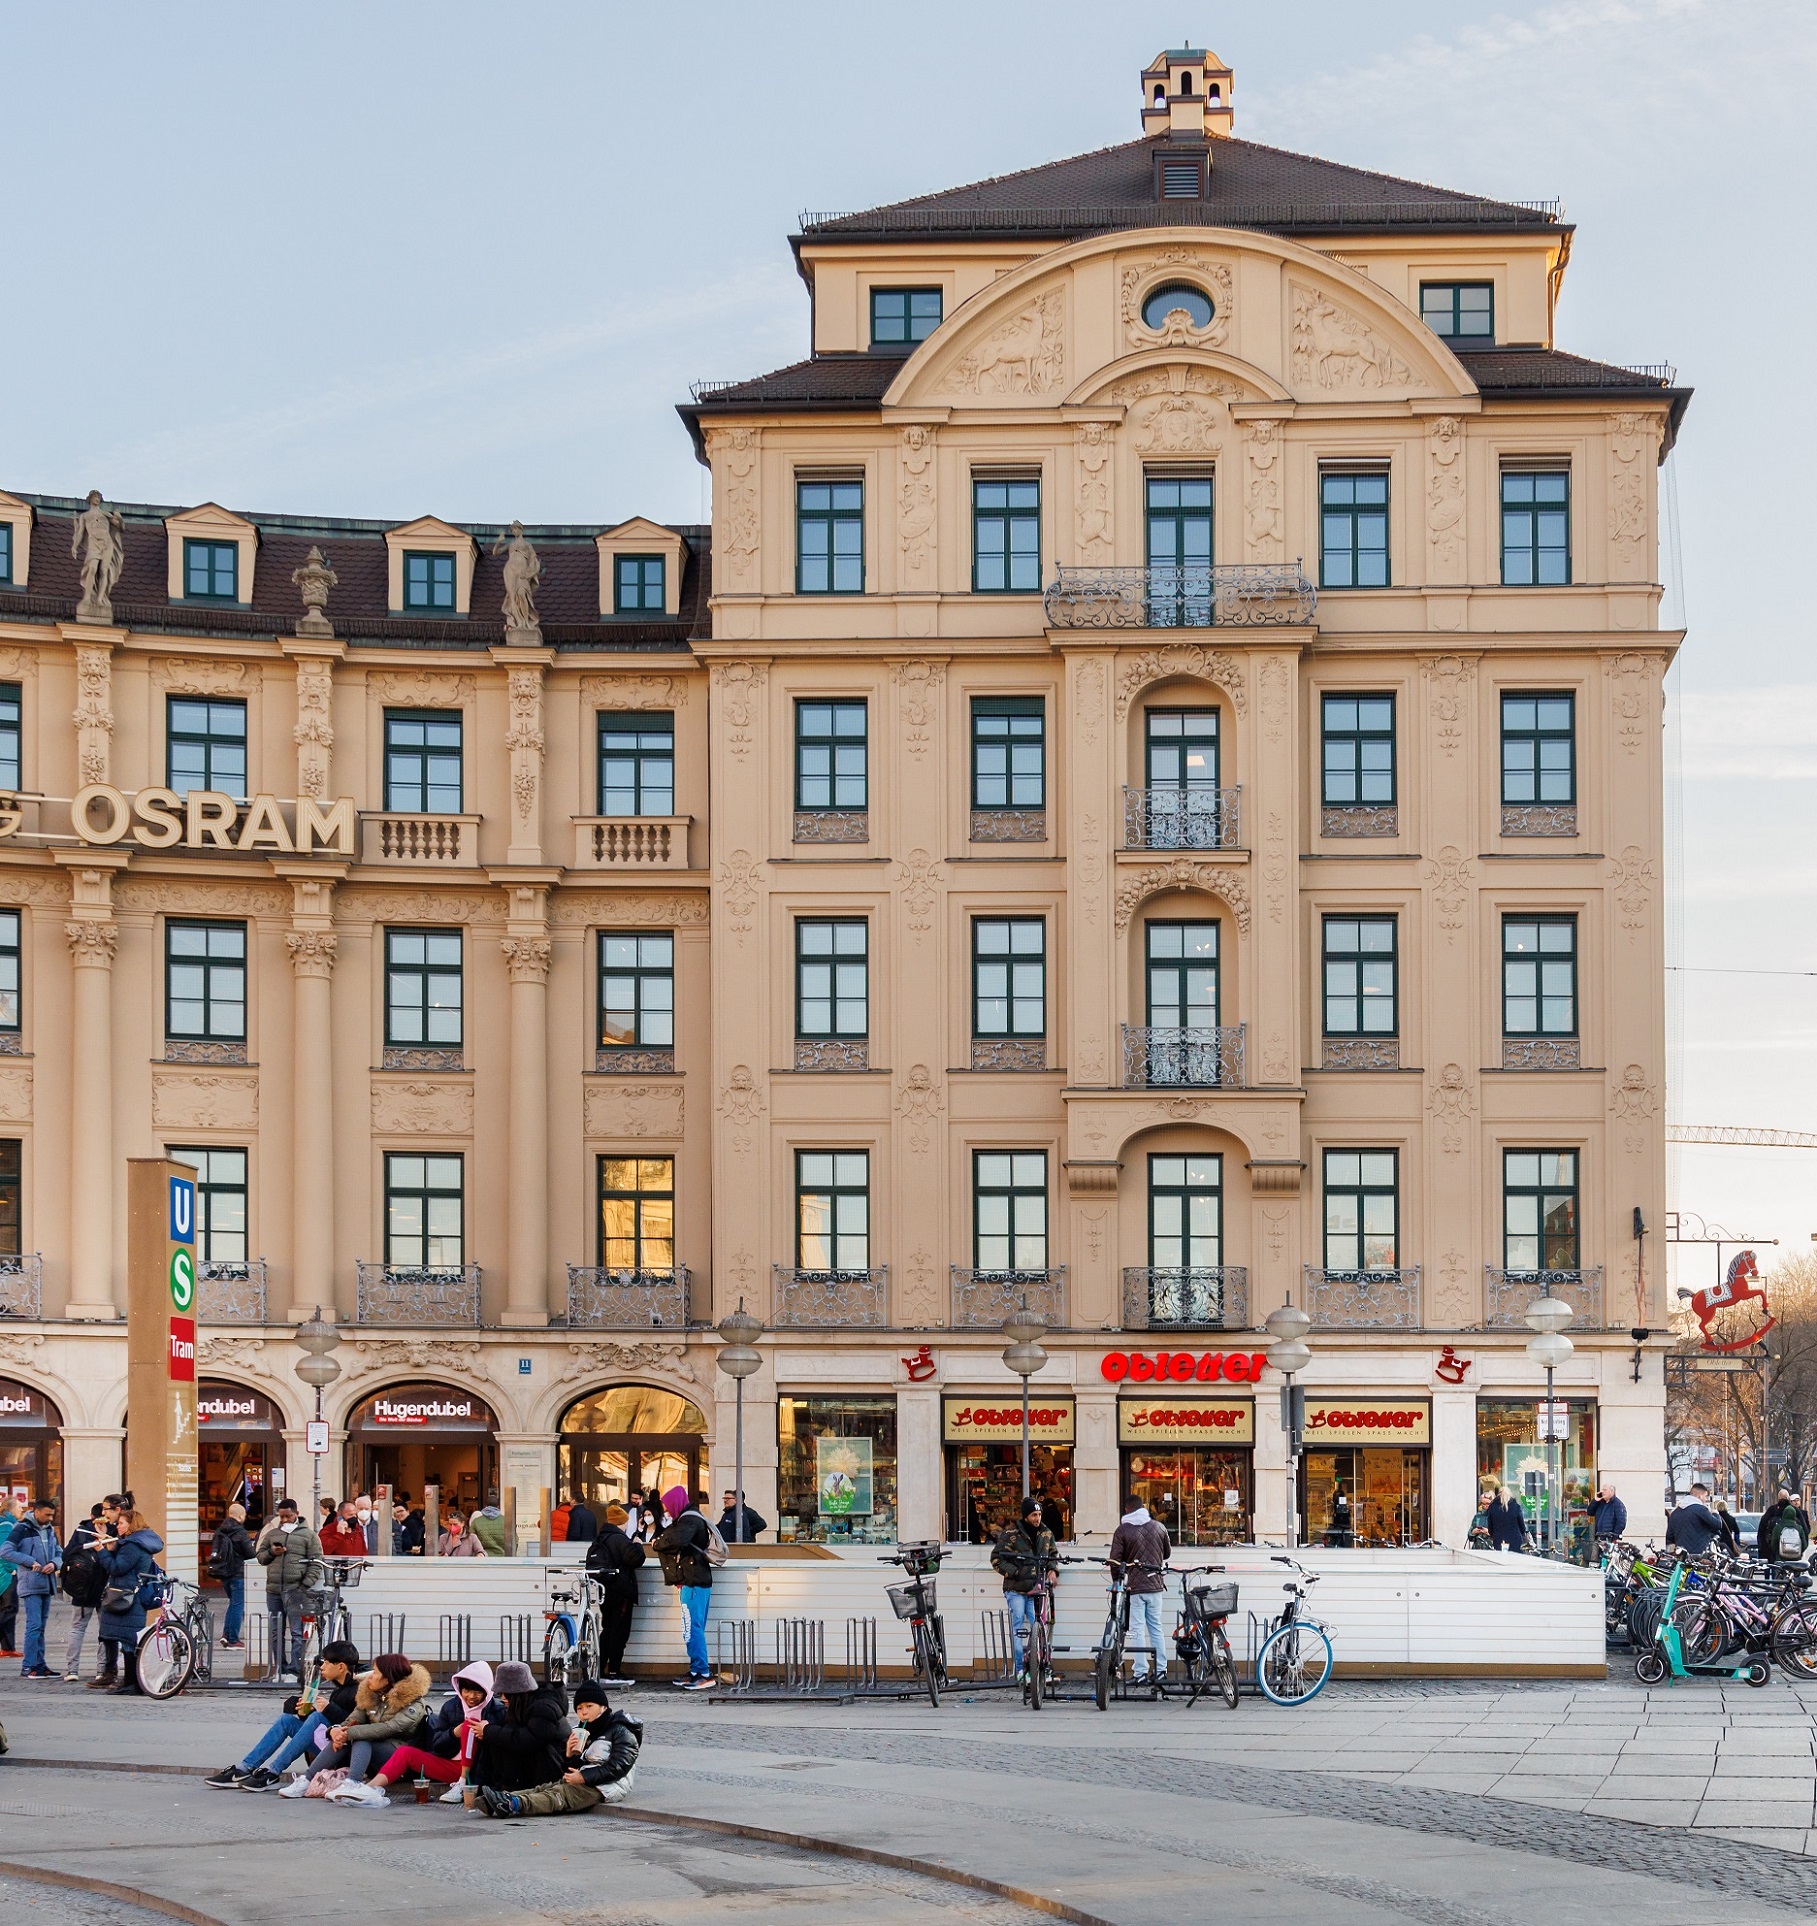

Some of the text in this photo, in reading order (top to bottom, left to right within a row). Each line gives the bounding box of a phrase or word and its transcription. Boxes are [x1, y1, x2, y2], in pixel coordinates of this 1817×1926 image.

[71, 782, 356, 855] OSRAM
[174, 1185, 191, 1235] U
[172, 1252, 192, 1308] S
[170, 1335, 194, 1359] Tram
[197, 1399, 255, 1414] ndubel
[374, 1400, 471, 1418] Hugendubel
